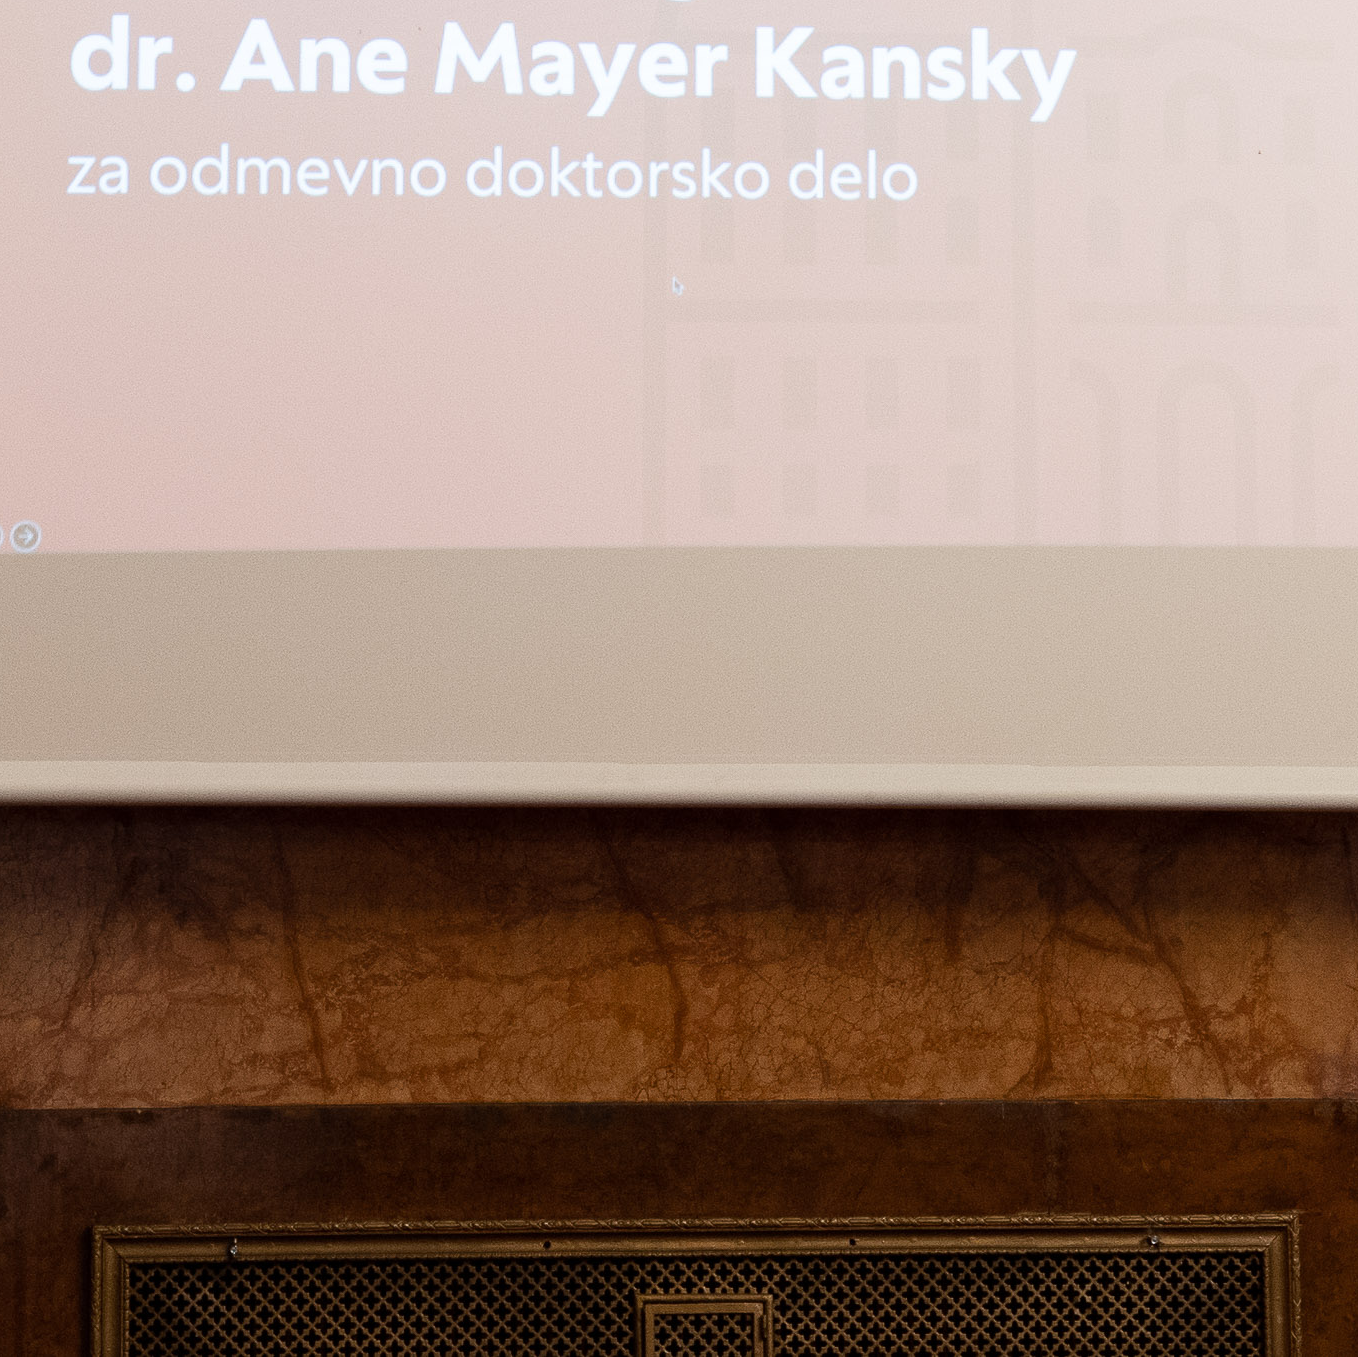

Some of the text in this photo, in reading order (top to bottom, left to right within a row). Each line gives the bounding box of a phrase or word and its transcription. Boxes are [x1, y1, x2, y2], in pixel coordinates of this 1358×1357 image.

[71, 14, 1077, 123] dr. Ane Mayer Kansky
[67, 143, 918, 201] za odmevno doktorsko delo
